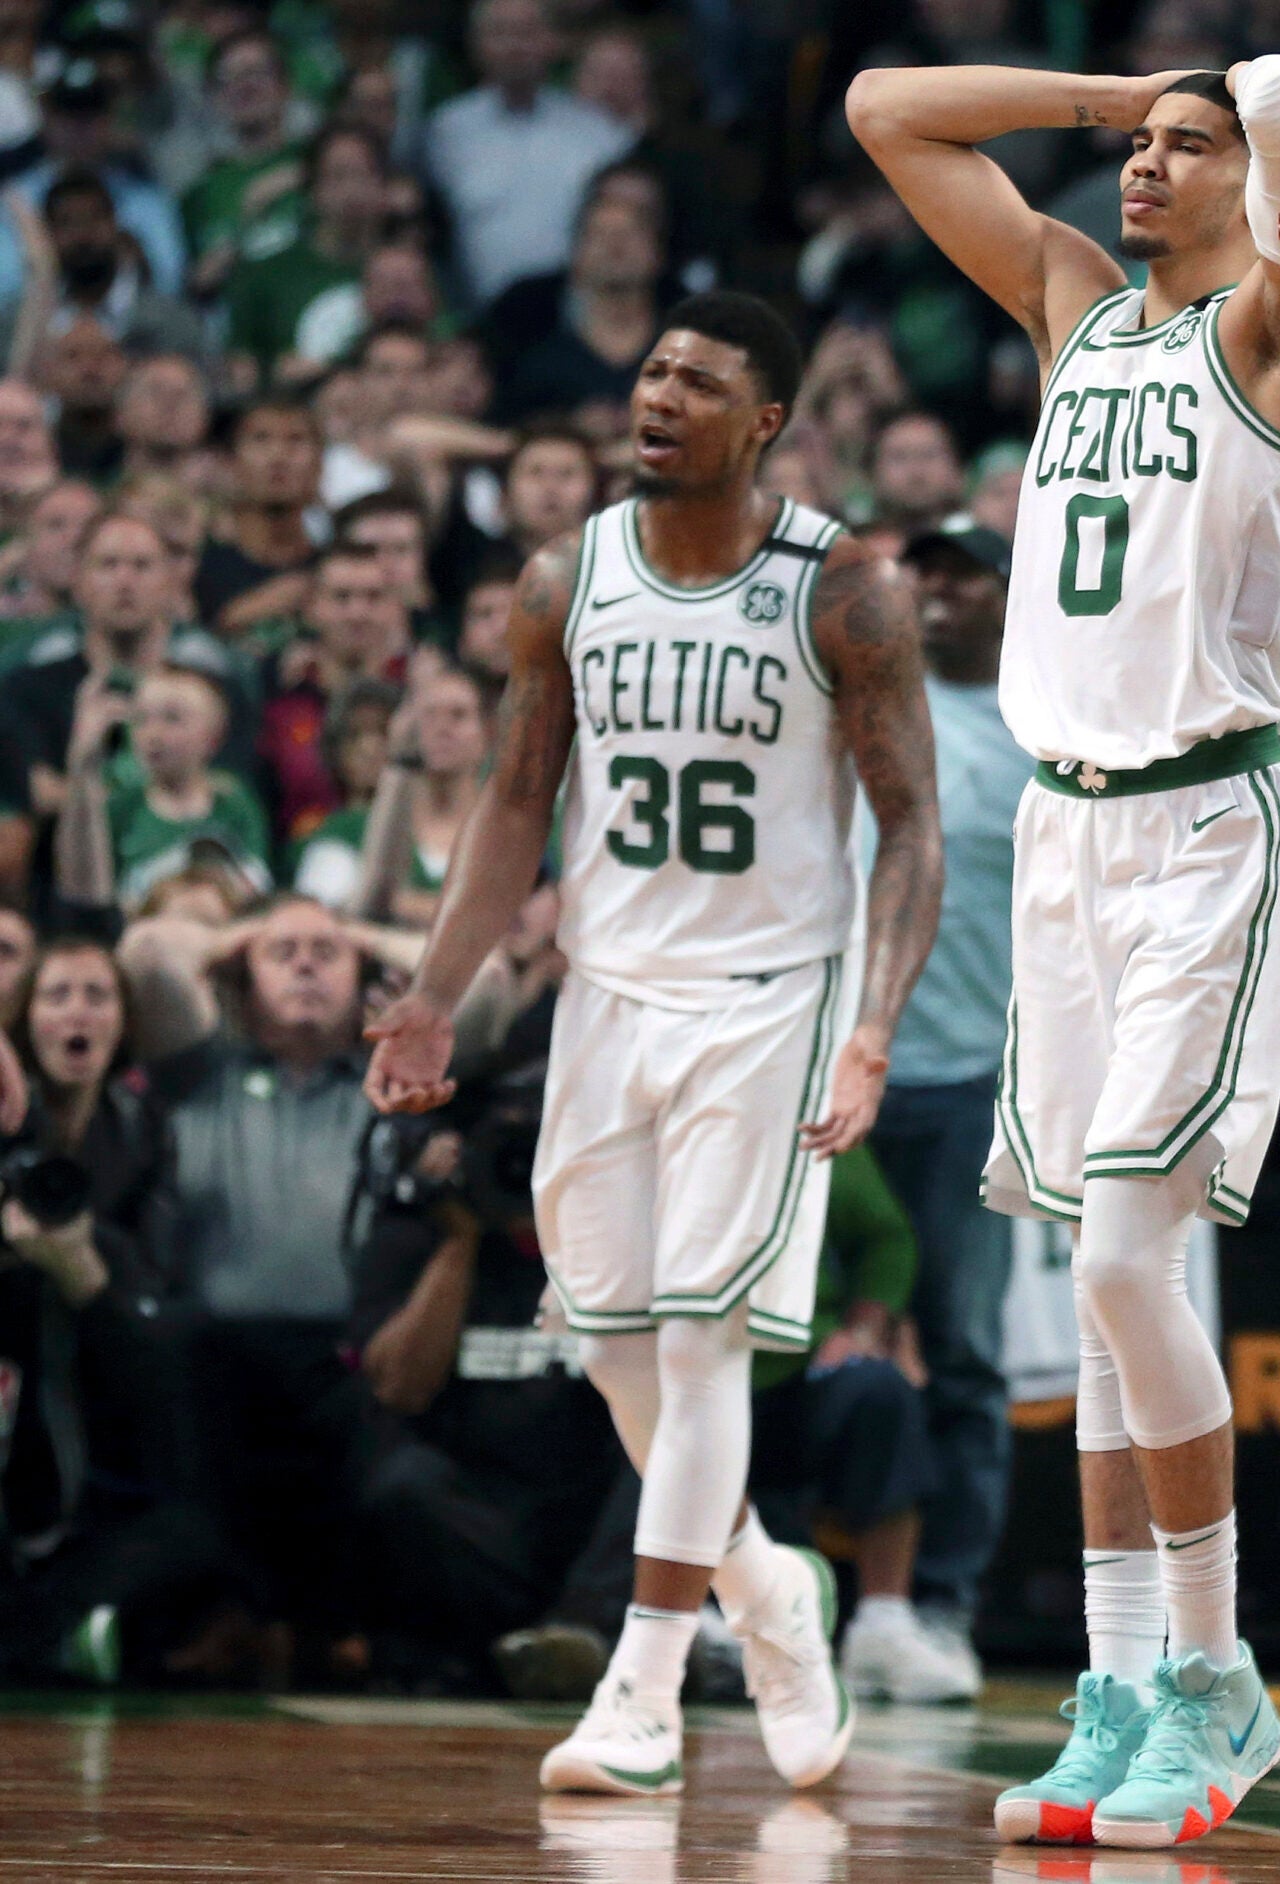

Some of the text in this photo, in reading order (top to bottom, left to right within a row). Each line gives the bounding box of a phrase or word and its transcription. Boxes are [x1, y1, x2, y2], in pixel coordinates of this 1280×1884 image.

[1034, 381, 1198, 488] CELTICS
[1057, 493, 1129, 617] 0
[581, 640, 787, 745] CELTICS
[606, 755, 756, 874] 36
